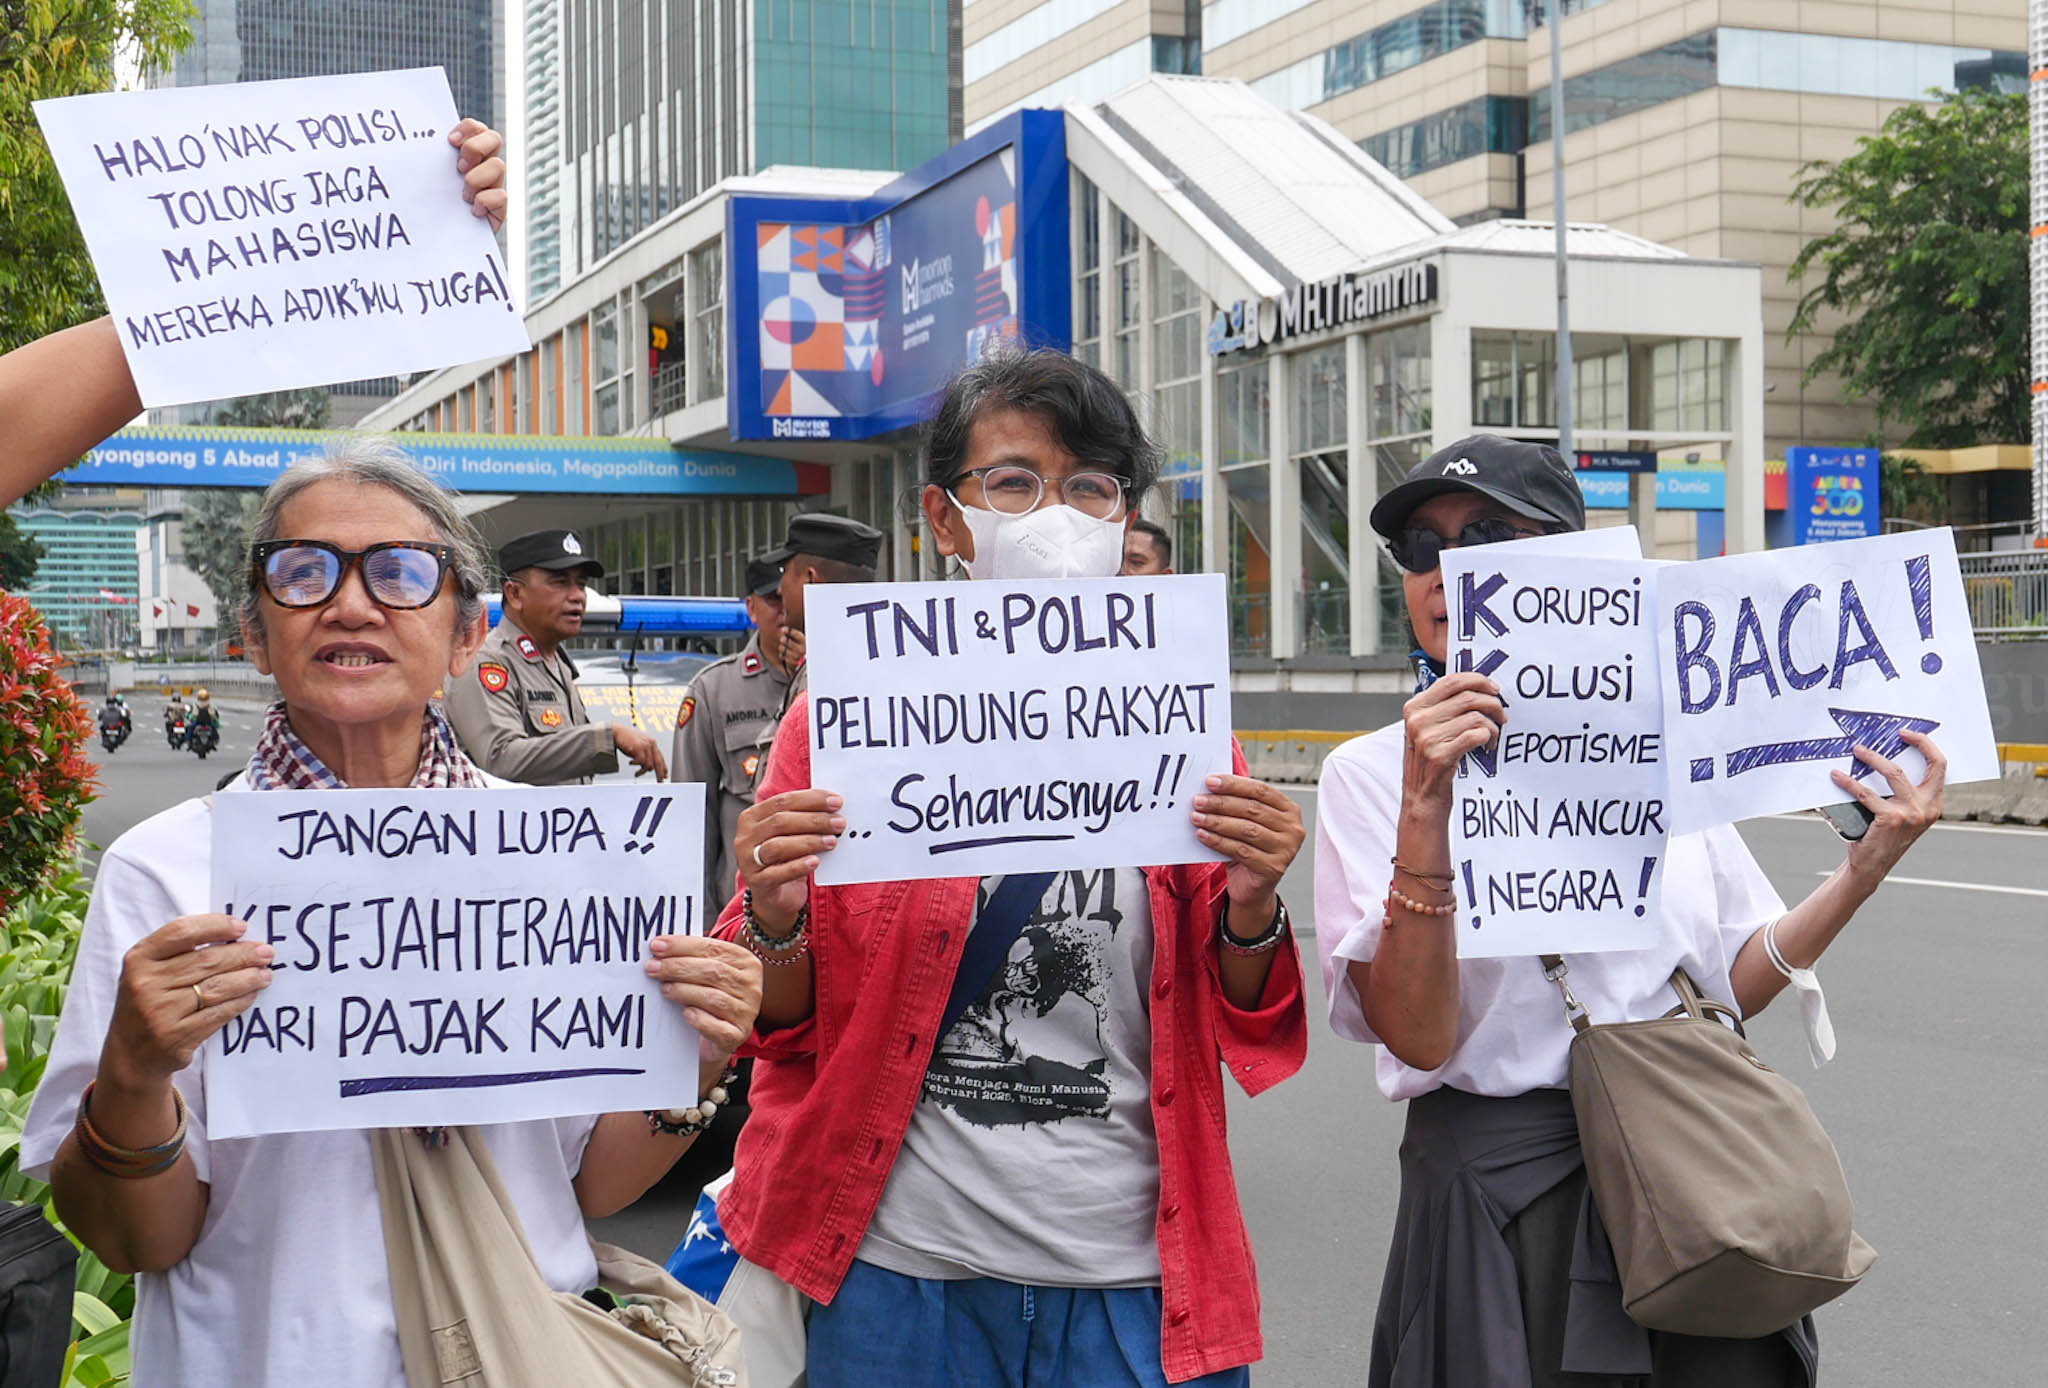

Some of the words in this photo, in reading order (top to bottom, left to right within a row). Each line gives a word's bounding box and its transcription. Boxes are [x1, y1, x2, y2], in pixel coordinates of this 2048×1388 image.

[149, 177, 297, 231] TOLONG
[303, 166, 389, 207] JAGA
[162, 212, 411, 284] MAHASISWA
[127, 295, 273, 349] MEREKA
[204, 451, 217, 467] 5
[223, 451, 279, 468] Abad
[423, 456, 456, 474] Diri
[462, 456, 558, 477] Indonesia,
[563, 457, 680, 479] Megapolitan
[684, 460, 737, 478] Dunia
[1668, 478, 1711, 494] Dunia
[846, 597, 959, 660] TNI
[974, 610, 998, 641] &
[1002, 592, 1156, 655] POLRI
[816, 689, 1049, 750] PELINDUNG
[1065, 683, 1215, 740] RAKYAT
[277, 805, 477, 860] JANGAN
[498, 806, 607, 855] LUPA
[1547, 798, 1665, 839] ANCUR
[1488, 868, 1624, 916] NEGARA
[222, 1004, 315, 1057] DARI
[338, 996, 509, 1058] PAJAK
[531, 993, 646, 1053] KAMI
[954, 1075, 1010, 1091] Menjaga
[1013, 1082, 1046, 1095] Bumi
[1051, 1084, 1107, 1096] Manusia
